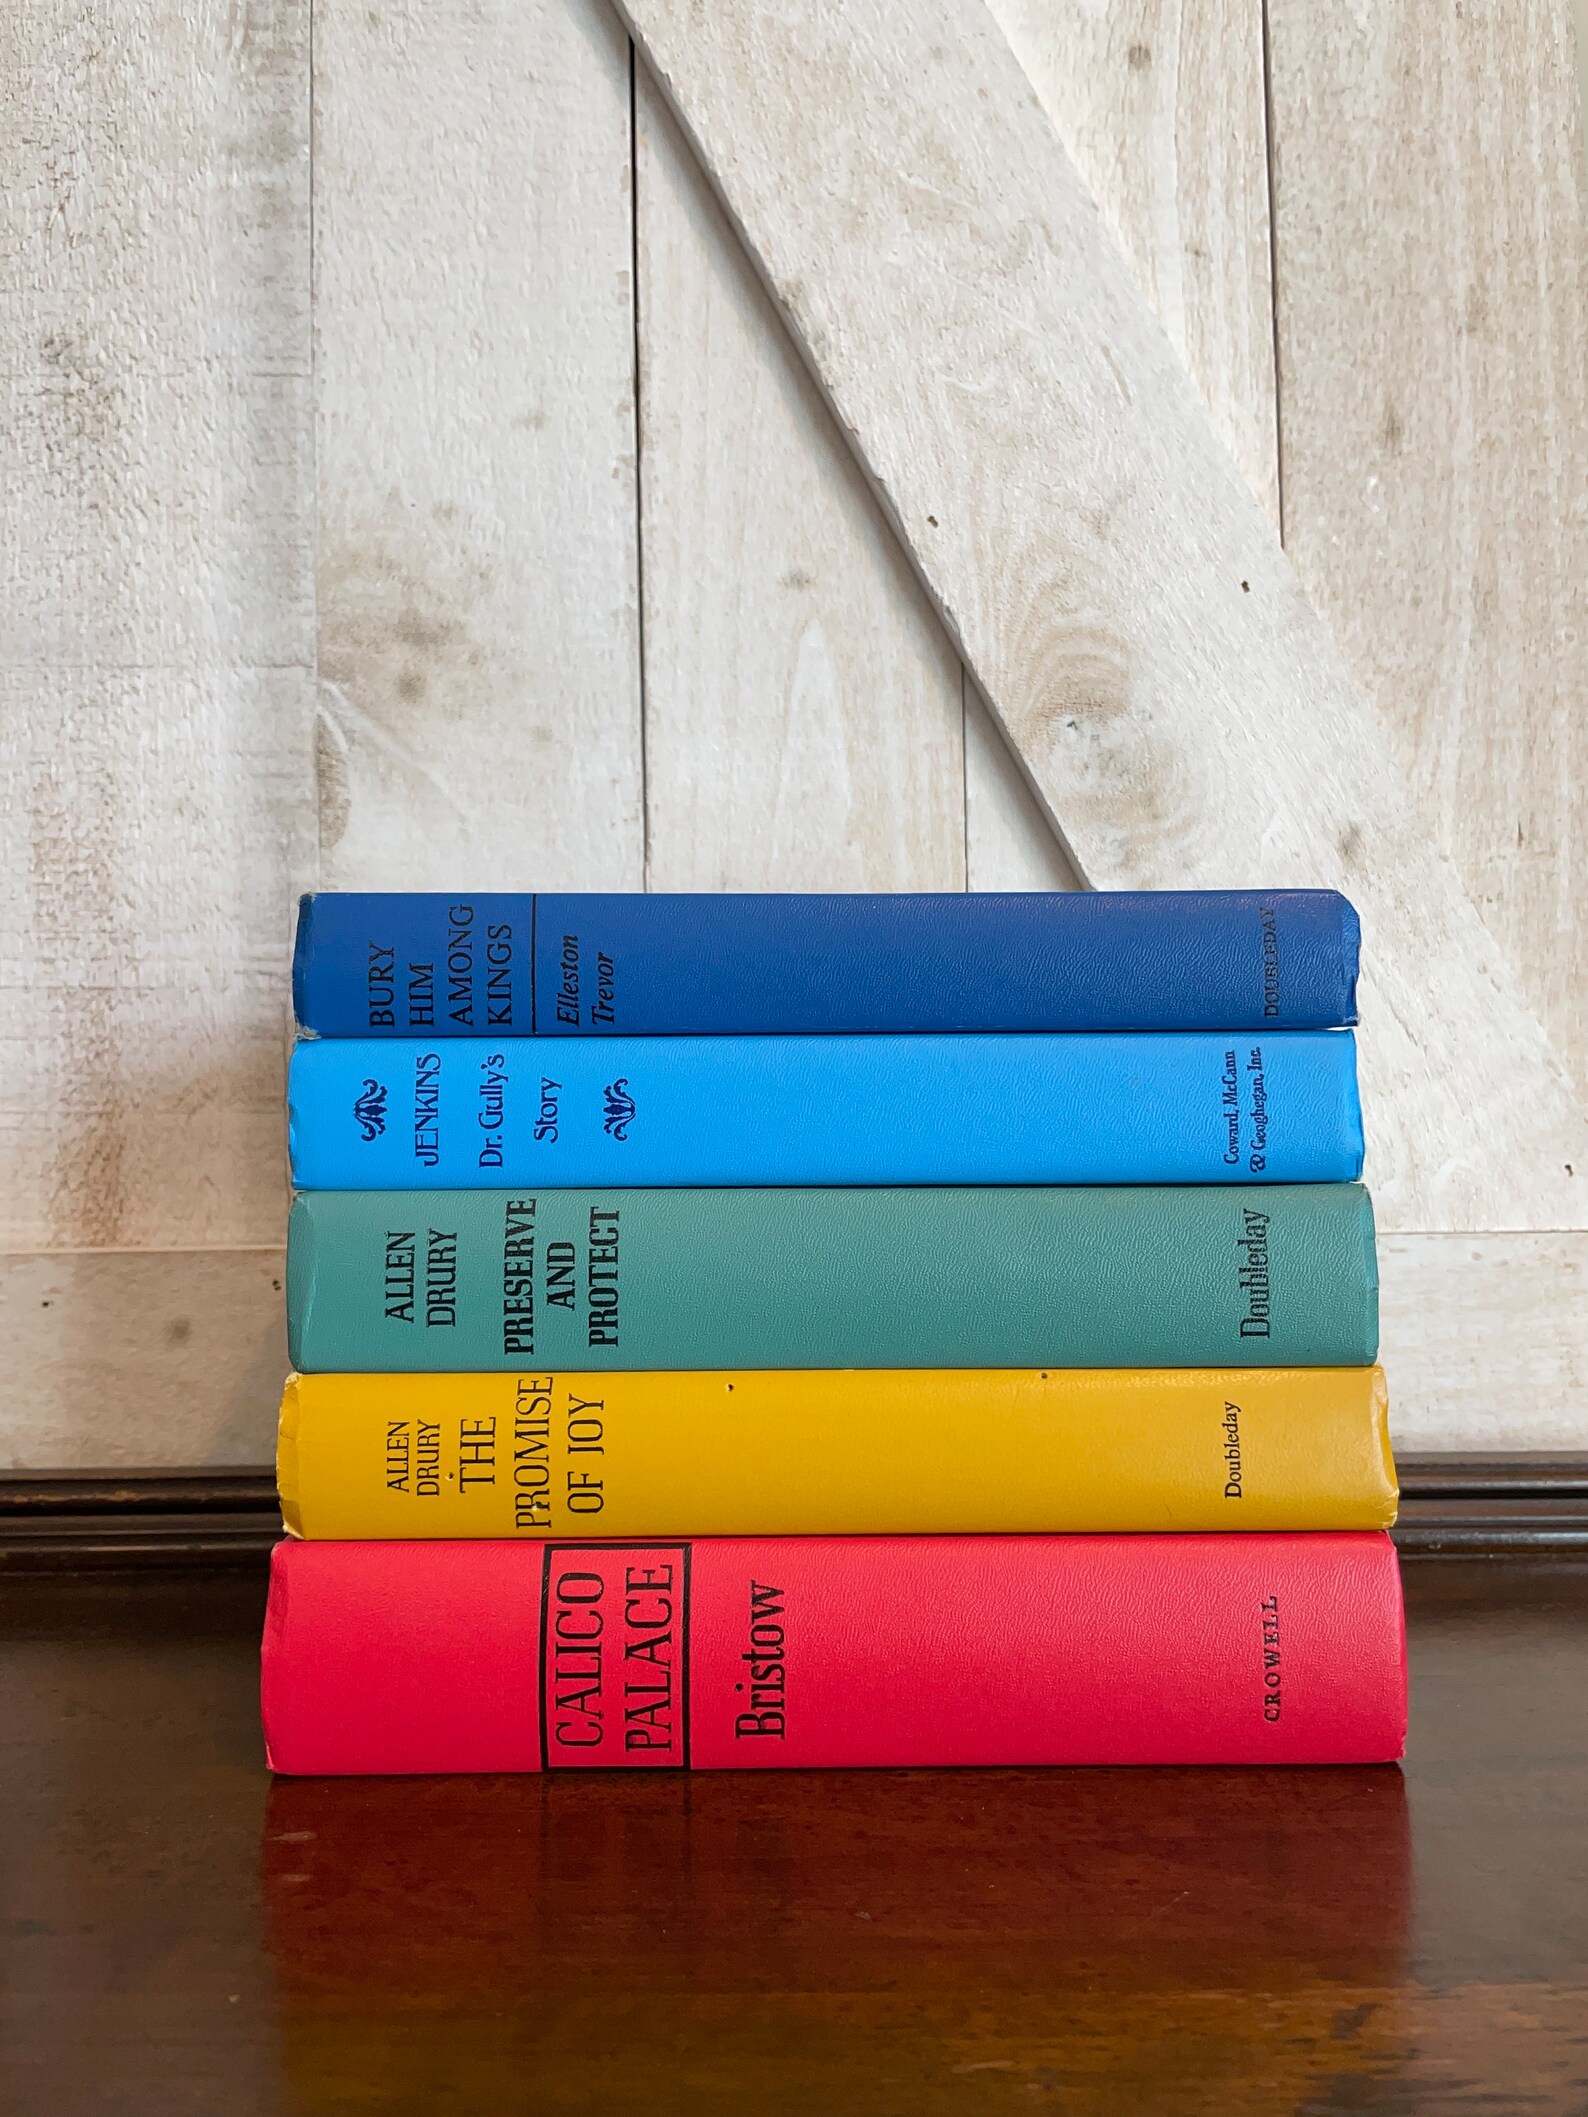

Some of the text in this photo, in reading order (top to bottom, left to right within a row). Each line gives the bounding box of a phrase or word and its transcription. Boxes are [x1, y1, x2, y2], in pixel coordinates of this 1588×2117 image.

[368, 940, 395, 1028] BURY
[408, 962, 434, 1027] HIM
[448, 904, 474, 1027] AMONG
[486, 924, 512, 1026] KINGS
[556, 935, 580, 1027] Elleston
[590, 951, 615, 1026] Trevor
[1260, 907, 1279, 1018] DOUBLEDAY
[415, 1053, 441, 1167] JENKINS
[478, 1053, 509, 1168] Dr. Gully's
[533, 1076, 563, 1144] Story
[1222, 1050, 1239, 1165] Coward, McCann
[1247, 1046, 1268, 1173] & Geoghegan, Inc.
[385, 1230, 416, 1324] ALLEN
[426, 1228, 457, 1328] DRURY
[503, 1198, 537, 1355] PRESERVE
[547, 1241, 576, 1311] AND
[588, 1206, 620, 1348] PROTECT
[1237, 1207, 1271, 1339] Doubleday
[386, 1420, 411, 1493] ALLEN
[416, 1419, 441, 1496] DRURY
[459, 1416, 496, 1493] THE
[513, 1376, 554, 1529] PROMISE
[567, 1393, 604, 1514] OF JOY
[1221, 1401, 1242, 1499] Doubleday
[555, 1572, 605, 1747] CALICO
[623, 1564, 673, 1752] PALACE
[734, 1579, 786, 1740] Bristow
[1261, 1596, 1281, 1722] CROWELL
